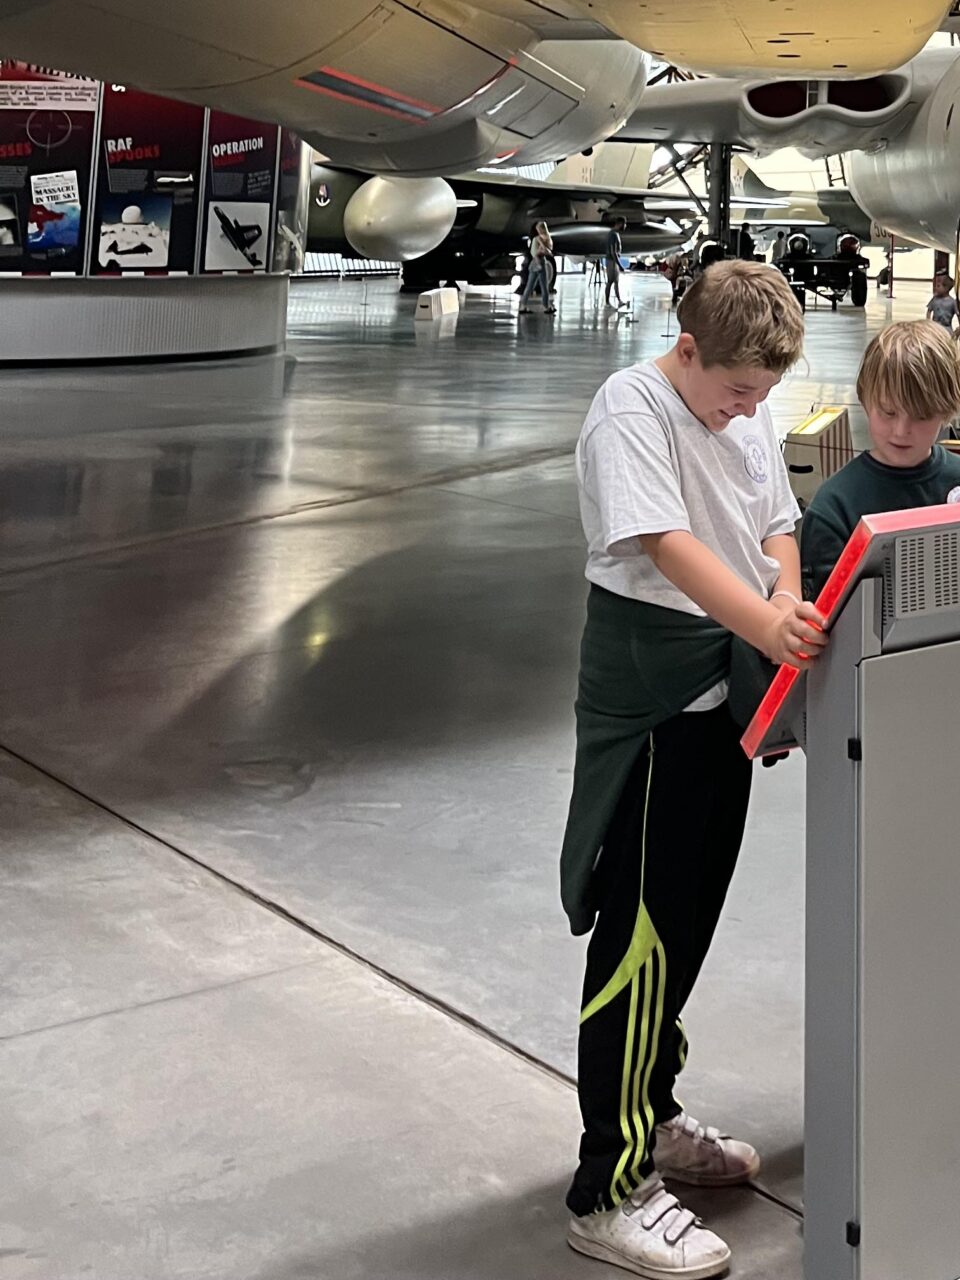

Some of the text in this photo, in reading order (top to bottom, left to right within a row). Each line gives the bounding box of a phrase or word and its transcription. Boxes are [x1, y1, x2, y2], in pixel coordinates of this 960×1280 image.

[107, 137, 133, 152] RAF
[213, 136, 264, 157] OPERATION
[34, 185, 75, 195] MASSACRE
[35, 196, 44, 204] IN
[45, 193, 61, 202] THE
